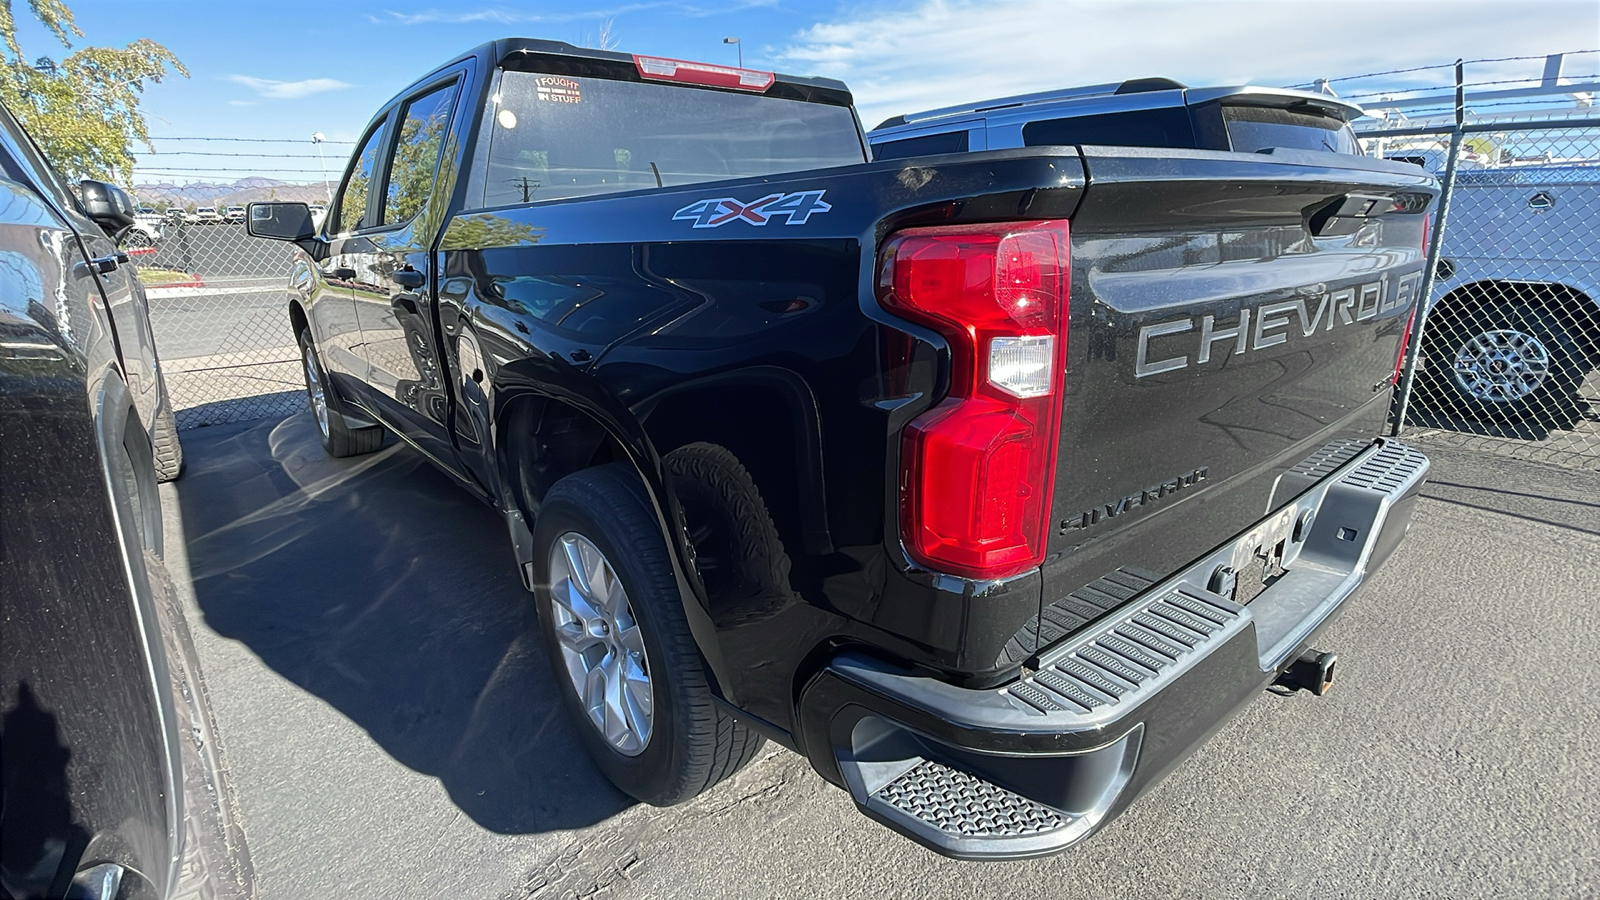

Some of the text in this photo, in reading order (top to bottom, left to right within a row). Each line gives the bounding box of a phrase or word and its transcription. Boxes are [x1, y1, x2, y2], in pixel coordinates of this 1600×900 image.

[538, 93, 581, 104] IN STUFF
[541, 77, 579, 90] FOUGHT
[1135, 270, 1422, 378] CHEVROLET
[1060, 466, 1208, 536] SILVERADO
